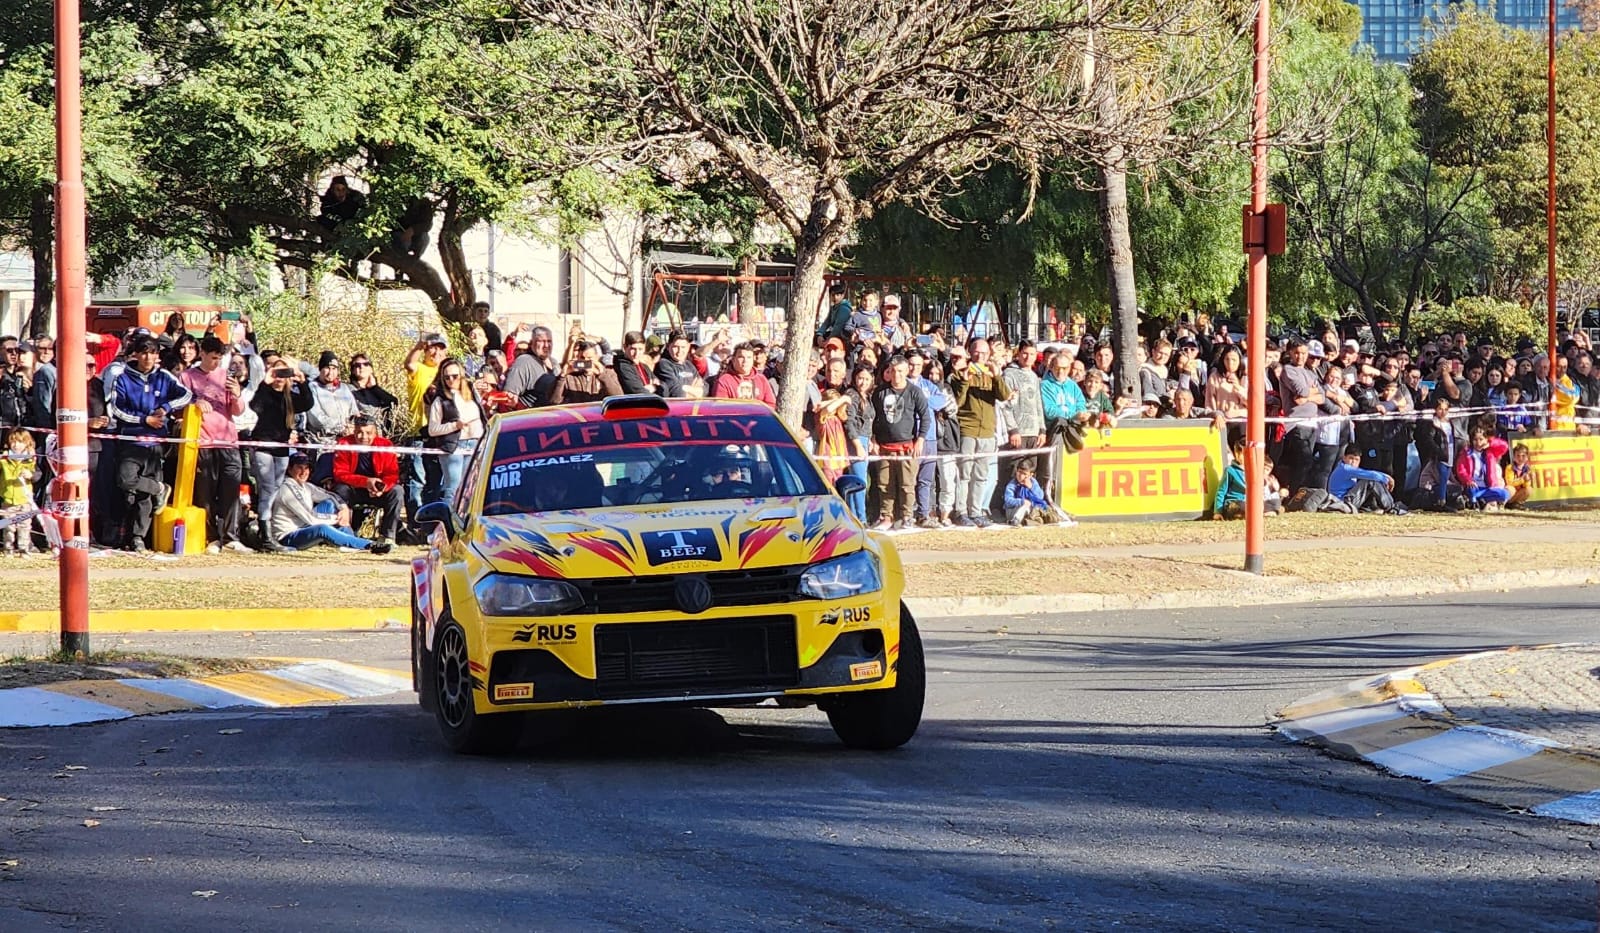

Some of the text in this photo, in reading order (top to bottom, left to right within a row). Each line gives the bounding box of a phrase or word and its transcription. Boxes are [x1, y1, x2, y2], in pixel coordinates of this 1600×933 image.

[518, 419, 759, 453] INFINITY
[494, 454, 594, 473] GONZALEZ
[1077, 445, 1209, 498] PIRELLI
[490, 471, 522, 490] MR
[657, 530, 698, 549] T
[660, 546, 707, 558] BEEF
[842, 606, 871, 623] RUS
[537, 624, 577, 641] RUS
[497, 686, 530, 698] PIRELLI
